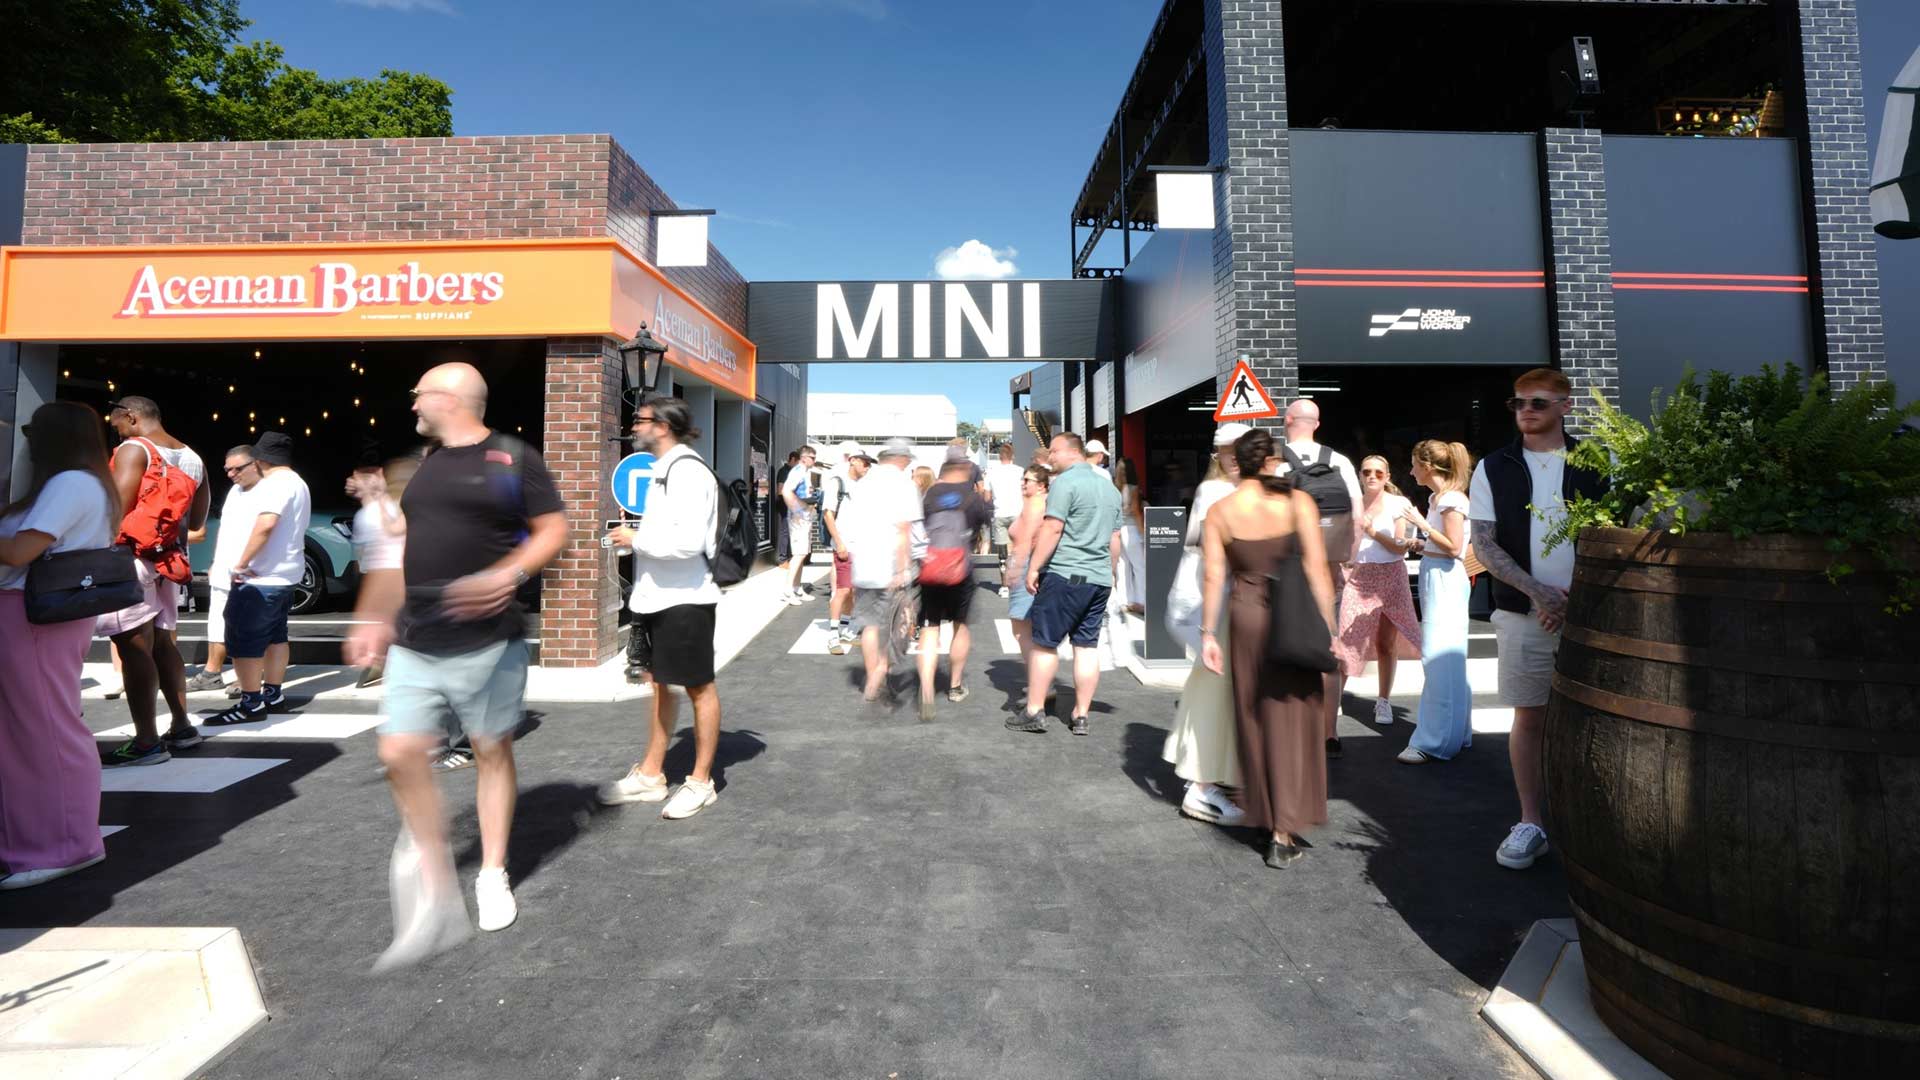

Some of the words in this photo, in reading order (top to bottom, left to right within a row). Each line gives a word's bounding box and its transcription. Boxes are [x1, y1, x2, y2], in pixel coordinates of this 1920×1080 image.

[116, 264, 308, 317] Aceman
[314, 261, 505, 315] Barbers
[816, 283, 1041, 358] MINI
[1420, 316, 1471, 324] COOPER
[651, 292, 700, 351] Aceman
[701, 324, 737, 371] Barbers
